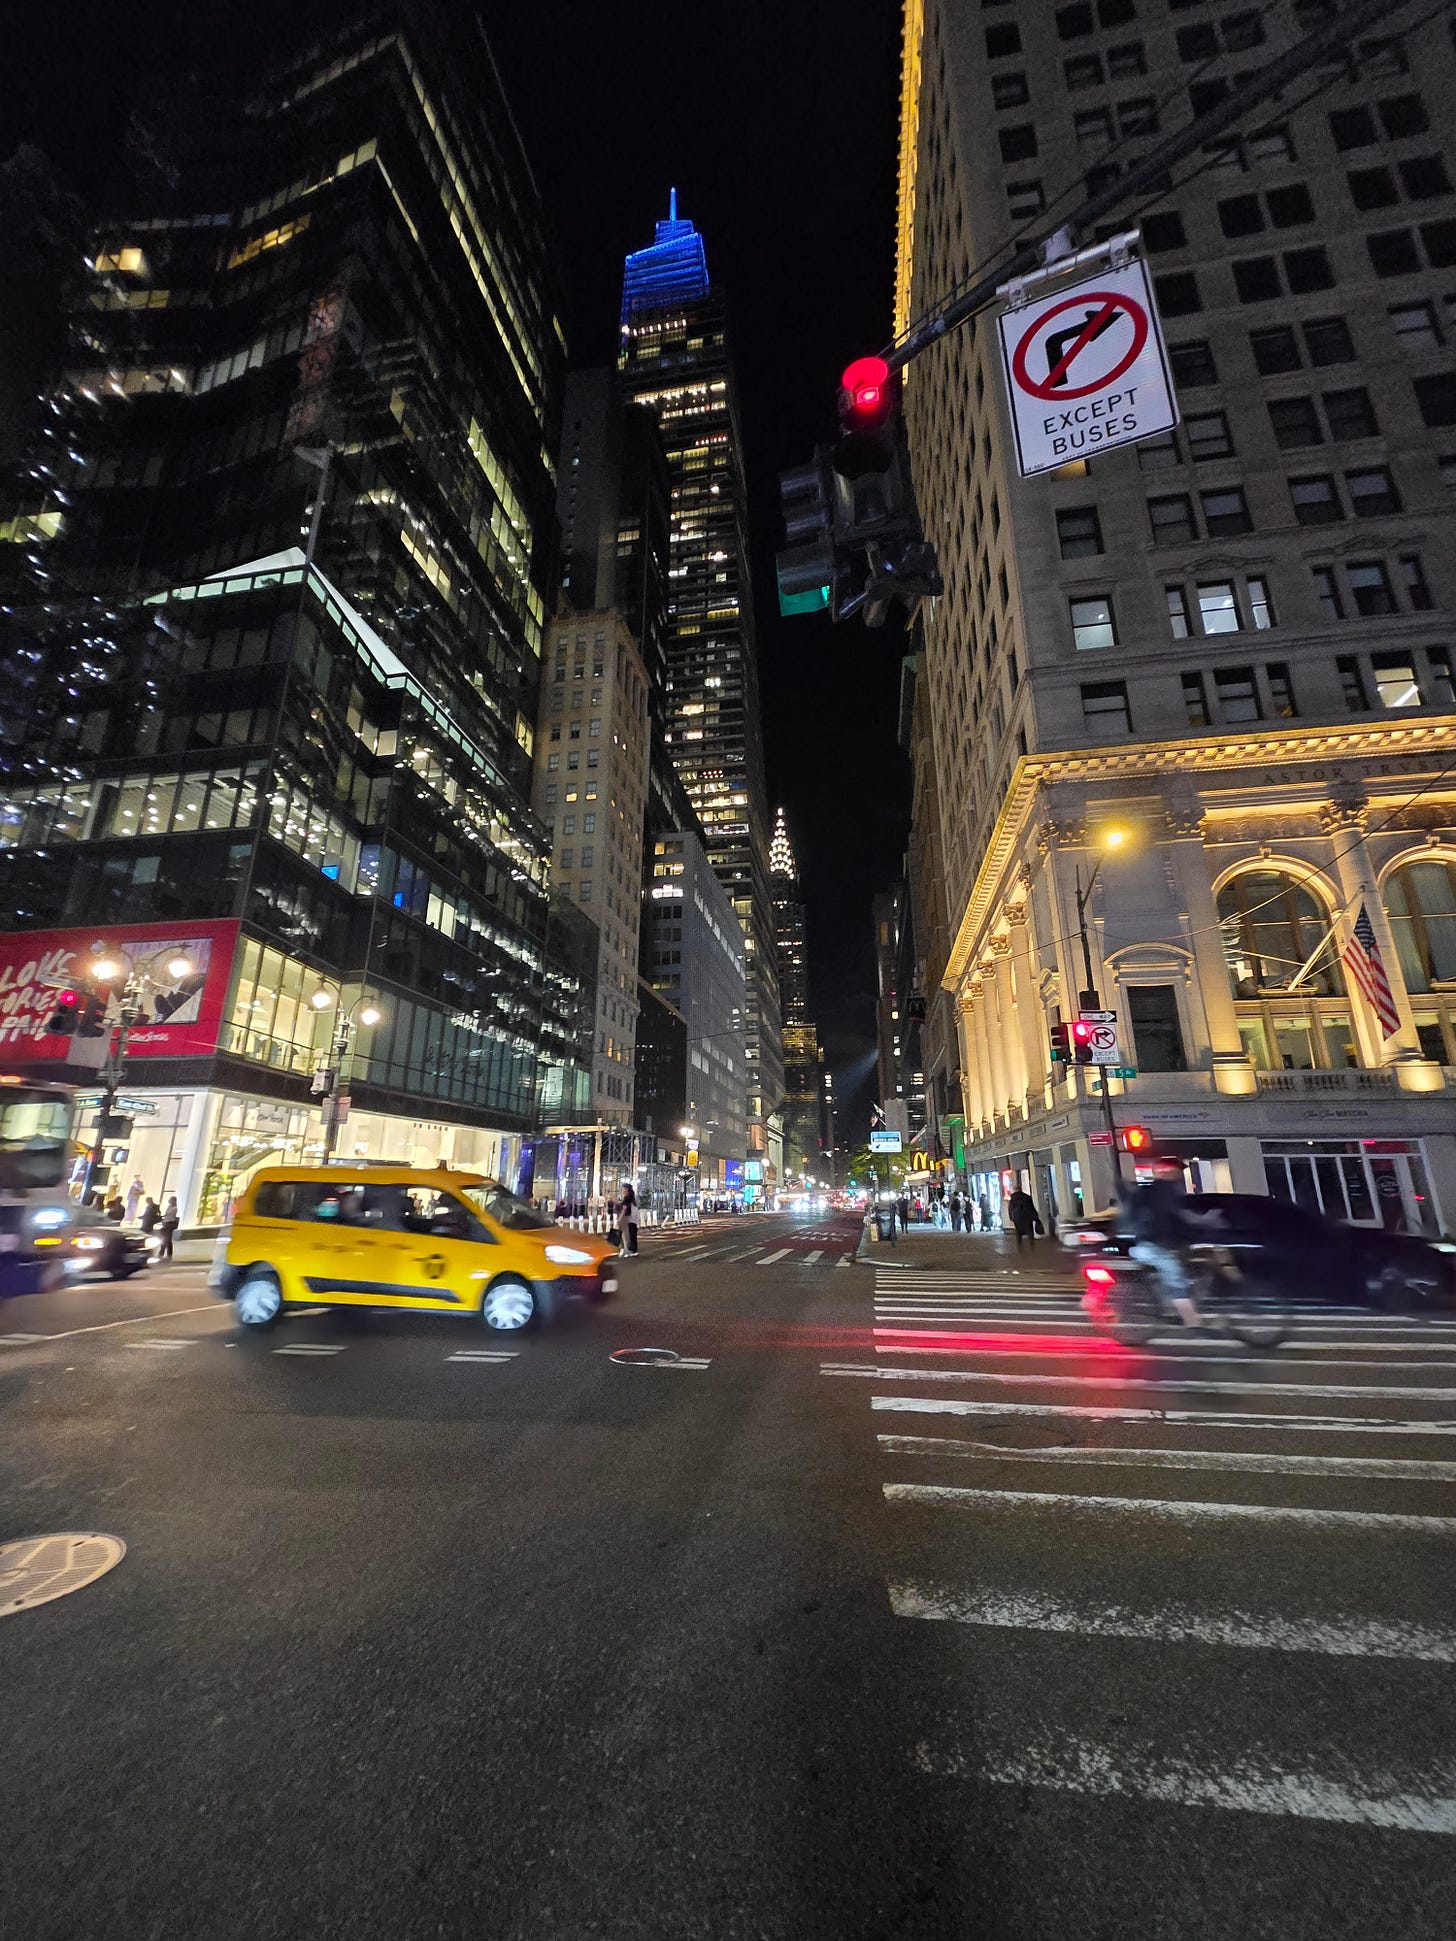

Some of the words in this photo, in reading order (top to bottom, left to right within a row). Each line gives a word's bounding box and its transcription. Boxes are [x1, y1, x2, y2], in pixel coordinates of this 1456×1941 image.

[1044, 388, 1138, 435] EXCEPT
[1053, 413, 1137, 456] BUSES
[1264, 768, 1344, 785] ASTOR
[0, 948, 76, 993] LOVE
[1119, 1069, 1124, 1077] 5
